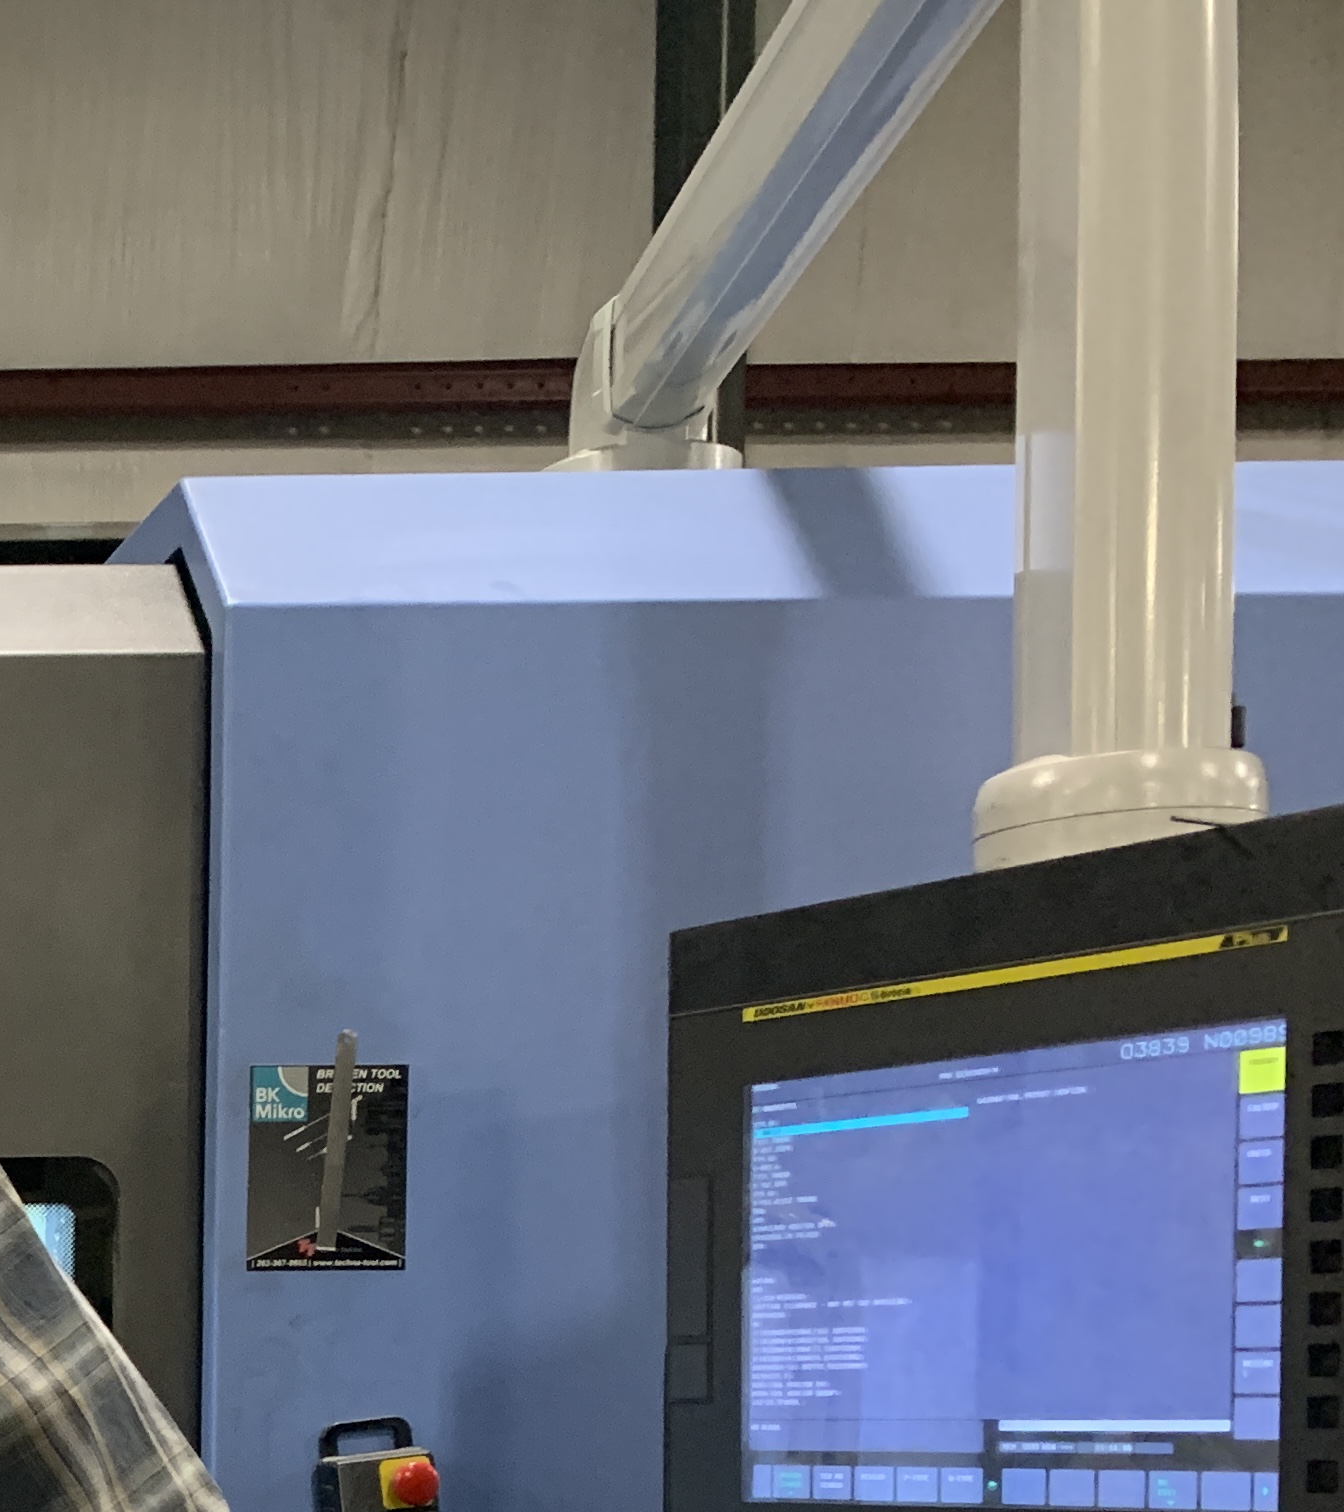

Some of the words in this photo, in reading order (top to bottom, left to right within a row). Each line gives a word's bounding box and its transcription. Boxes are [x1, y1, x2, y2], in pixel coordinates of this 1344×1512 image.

[316, 1069, 367, 1080] BREN
[371, 1069, 402, 1079] TOOL
[255, 1087, 280, 1103] BK
[316, 1082, 384, 1094] DECTION
[255, 1103, 305, 1119] Mikro
